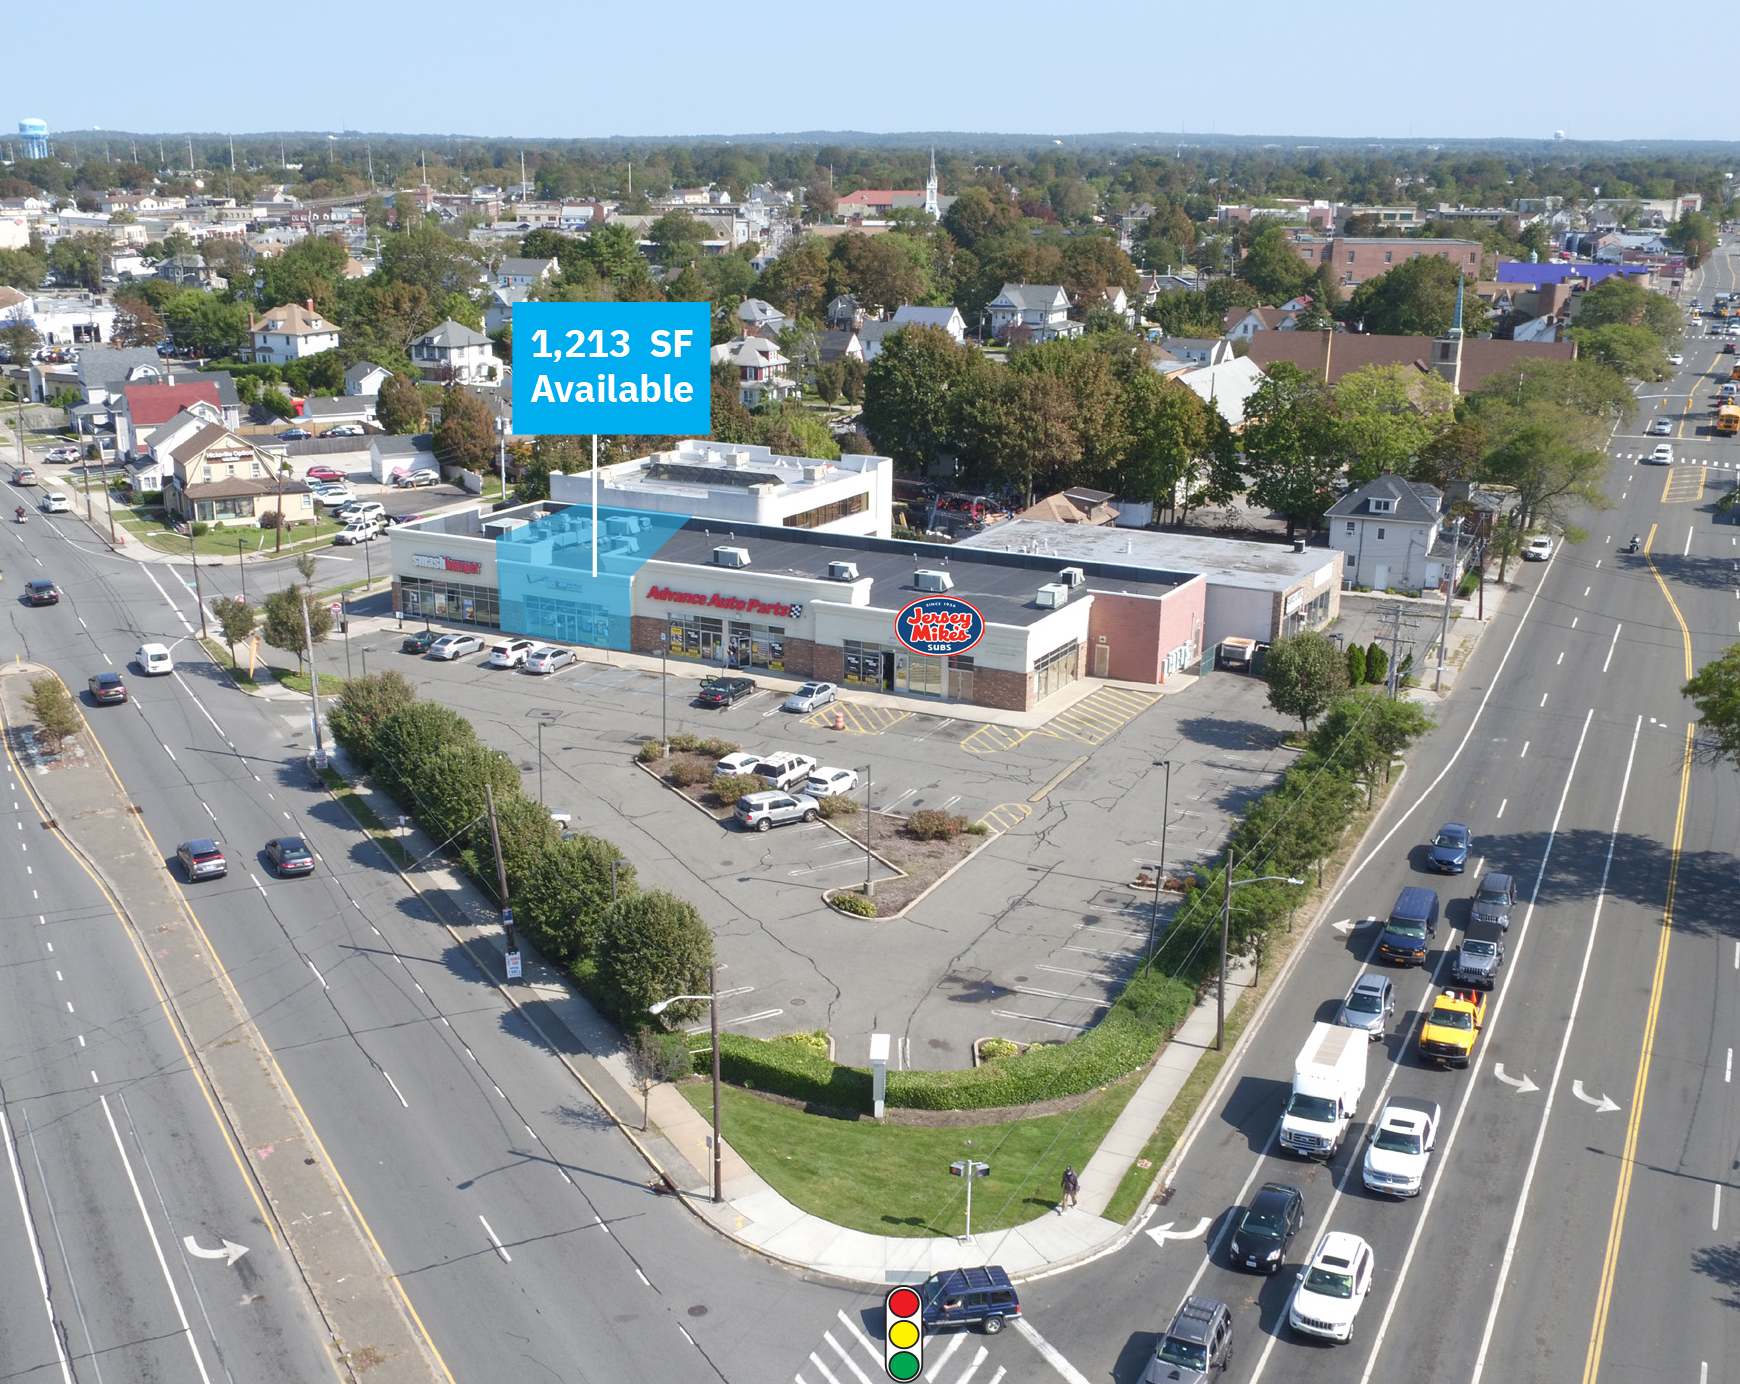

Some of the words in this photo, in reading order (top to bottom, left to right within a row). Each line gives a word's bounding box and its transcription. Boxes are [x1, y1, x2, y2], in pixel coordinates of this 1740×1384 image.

[646, 586, 707, 606] Advance
[707, 593, 746, 611] Auto
[746, 598, 789, 617] Parts
